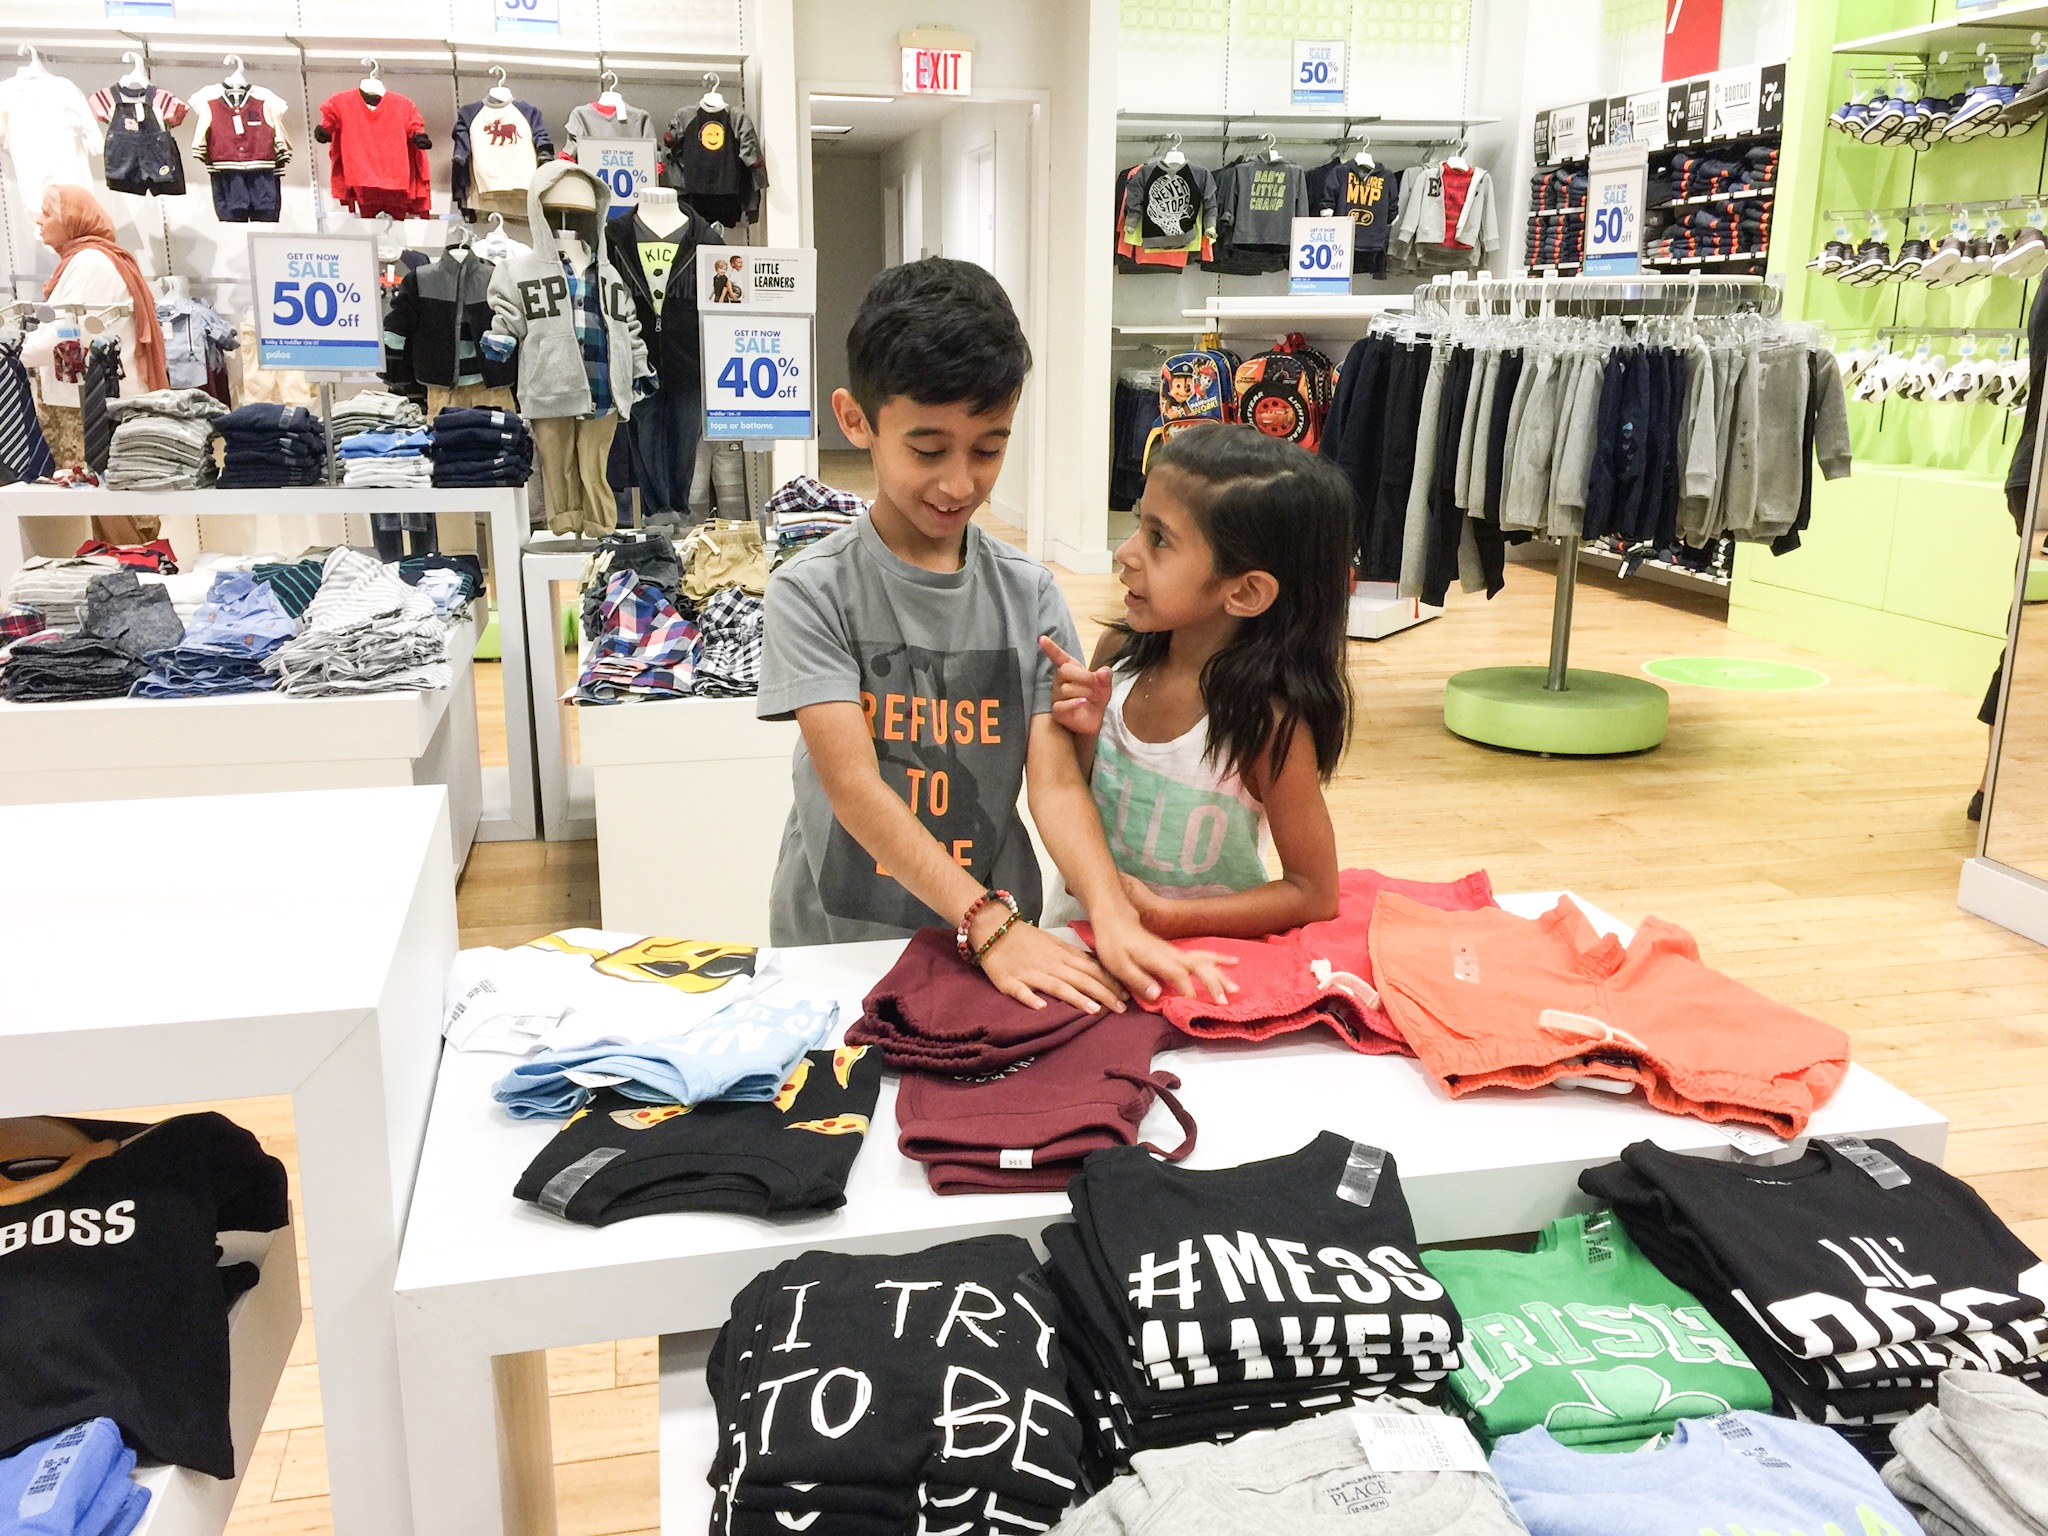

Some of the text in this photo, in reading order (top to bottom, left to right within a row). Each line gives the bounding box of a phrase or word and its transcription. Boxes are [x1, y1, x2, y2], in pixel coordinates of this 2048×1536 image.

[1308, 51, 1331, 60] SALE
[916, 51, 961, 90] EXIT
[1300, 61, 1339, 84] 50%
[1724, 82, 1752, 102] BOOTCUT
[1636, 101, 1660, 120] STRAIGHT
[602, 155, 634, 167] SALE
[1154, 178, 1189, 204] NEVER
[1250, 183, 1286, 198] LITTLE
[1347, 172, 1385, 189] FUURE
[1346, 183, 1381, 207] MVP
[1603, 190, 1627, 205] SALE
[1593, 205, 1634, 244] 50% off
[1309, 232, 1335, 242] SALE
[645, 249, 675, 263] KIC
[1299, 244, 1344, 270] 30% off
[288, 260, 340, 279] SALE
[754, 263, 779, 275] LITTLE
[754, 276, 795, 289] LEARNERS
[273, 281, 361, 327] 50% off
[734, 329, 749, 337] GET
[266, 350, 291, 360] polos
[735, 337, 781, 354] SALE
[717, 357, 799, 399] 40% off
[710, 421, 728, 430] tops
[740, 421, 773, 429] bottoms
[1287, 396, 1305, 442] LIGHTYEAR
[860, 690, 1001, 745] REFUSE
[906, 767, 949, 817] TO
[0, 1199, 136, 1257] BOSS
[1128, 1230, 1446, 1311] #MESS
[1817, 1236, 1938, 1289] LIL'
[772, 1279, 1056, 1369] I TRY
[1450, 1301, 1760, 1409] IRISH
[757, 1364, 1078, 1492] TO BE
[1326, 1486, 1341, 1494] THE
[1330, 1480, 1392, 1506] PLACE
